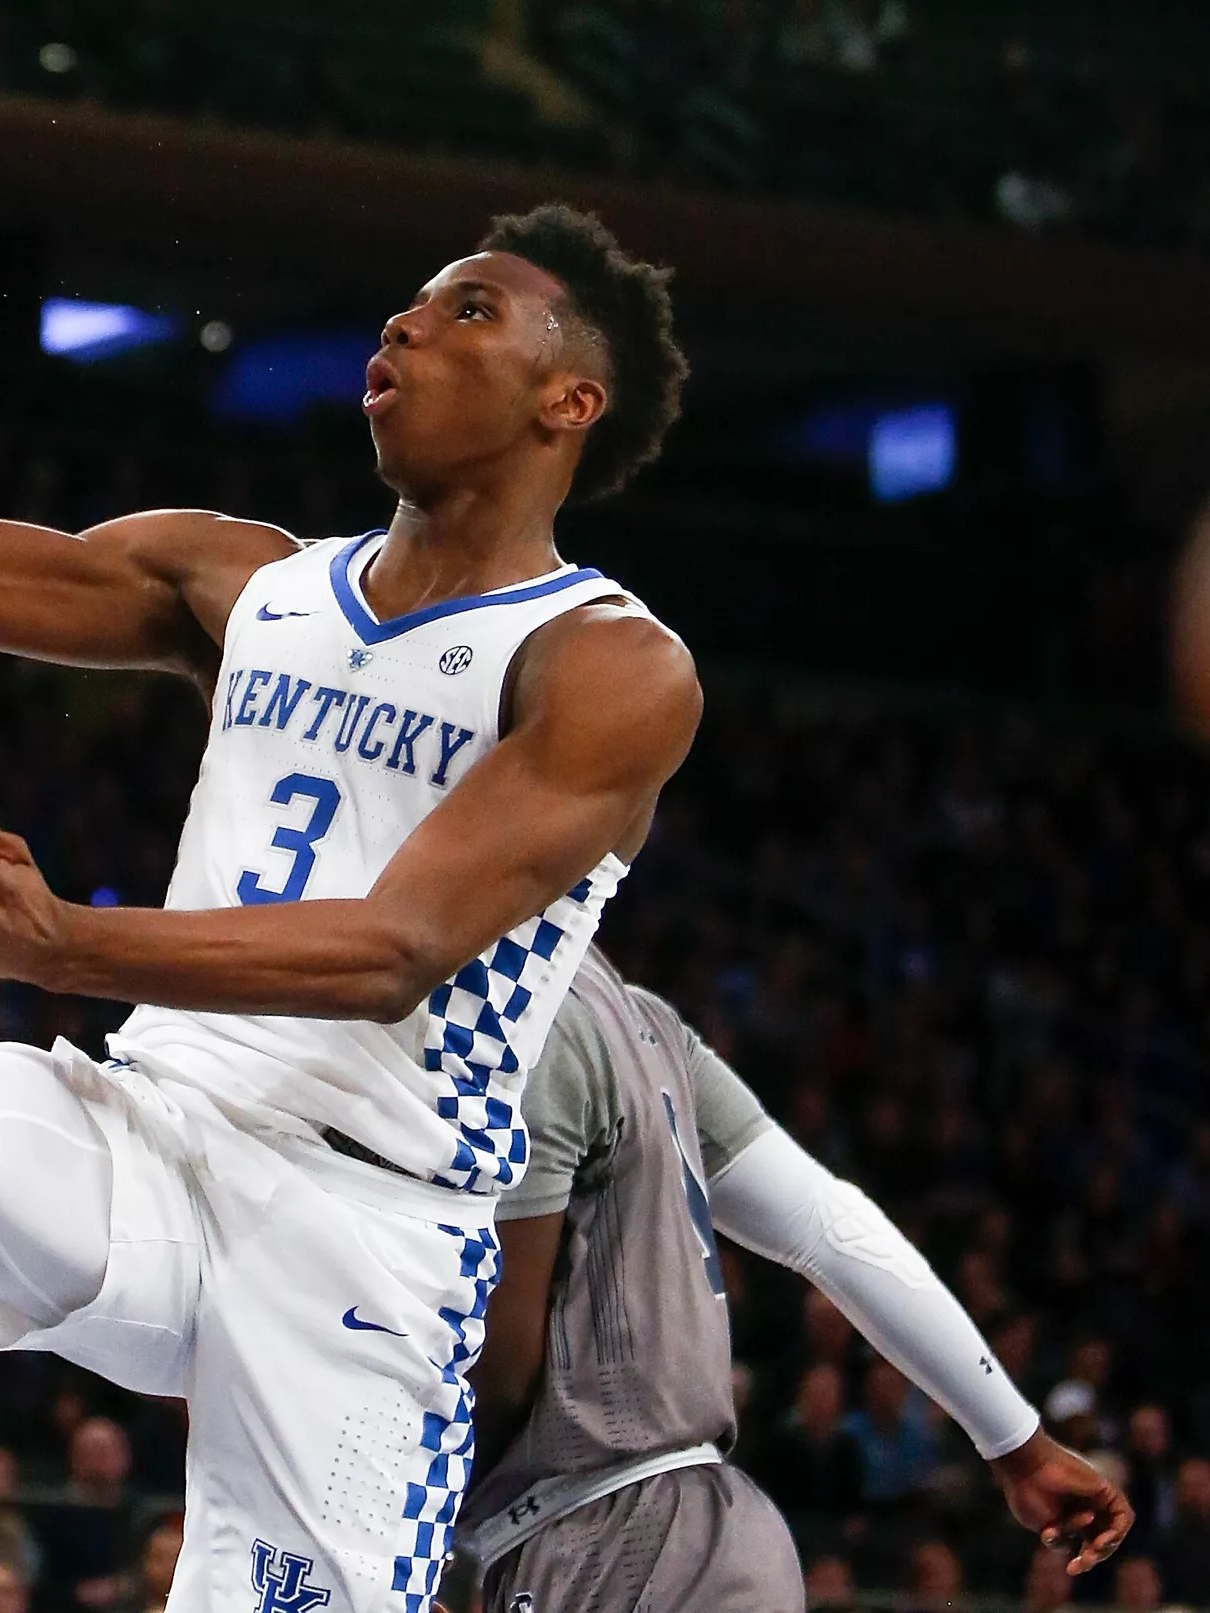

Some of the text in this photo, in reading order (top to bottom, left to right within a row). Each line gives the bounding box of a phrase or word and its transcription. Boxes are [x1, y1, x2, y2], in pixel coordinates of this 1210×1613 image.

[439, 645, 473, 676] SEC
[222, 669, 474, 786] KENTUCKY
[236, 772, 342, 906] 3
